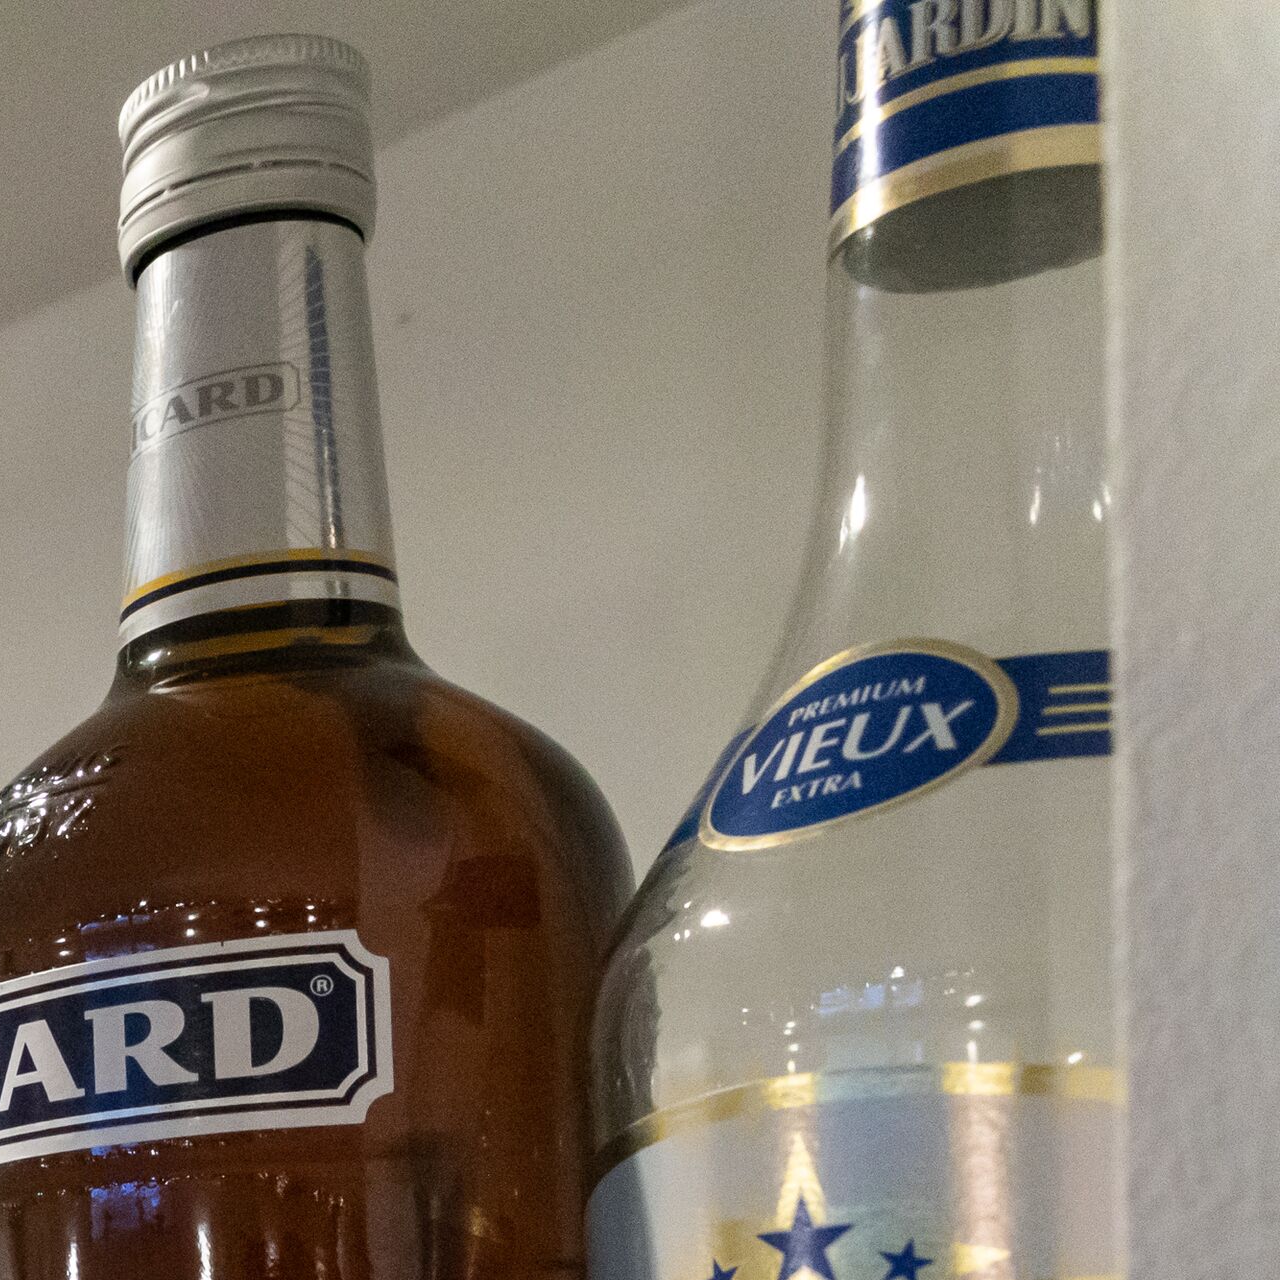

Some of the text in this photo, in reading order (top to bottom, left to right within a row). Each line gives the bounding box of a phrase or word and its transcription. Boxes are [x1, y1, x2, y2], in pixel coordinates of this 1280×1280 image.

[788, 676, 927, 727] PREMIUM
[740, 698, 976, 796] VIEUX
[770, 771, 864, 809] EXTRA
